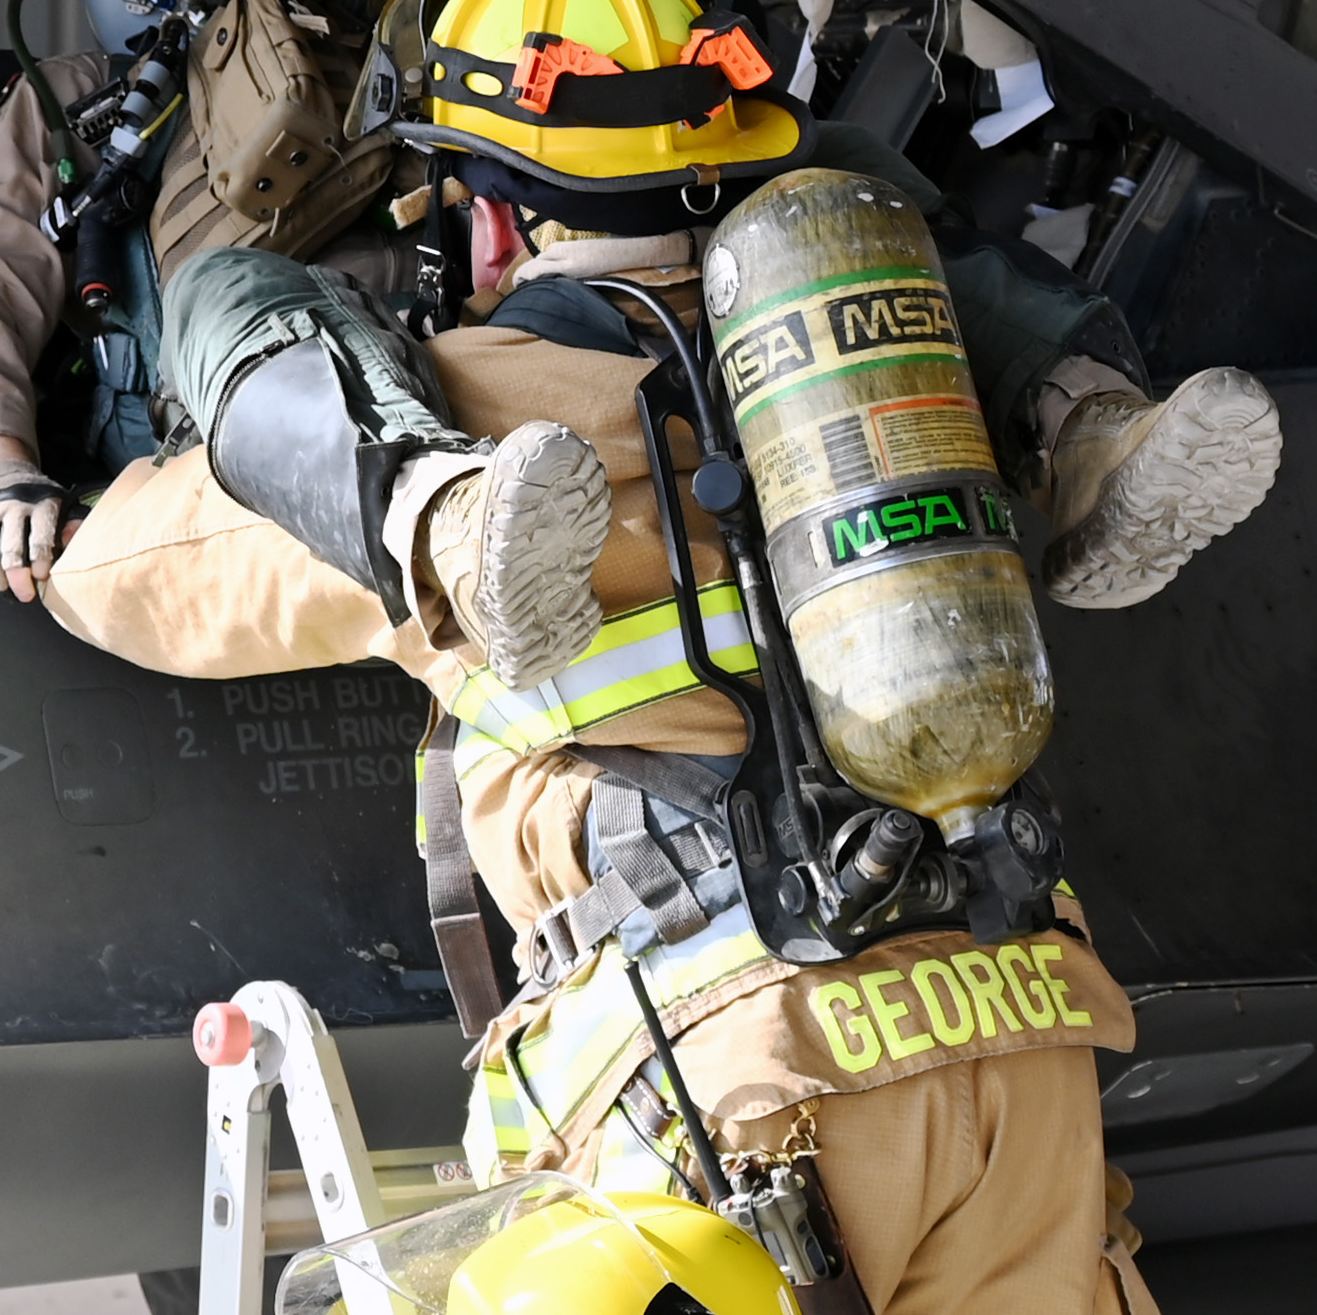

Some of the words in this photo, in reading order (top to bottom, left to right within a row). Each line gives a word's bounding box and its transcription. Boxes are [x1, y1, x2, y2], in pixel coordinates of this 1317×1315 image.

[842, 296, 958, 346] MSA
[724, 326, 807, 401] MSA
[831, 495, 967, 560] MSA
[166, 687, 195, 719] 1.
[221, 679, 321, 716] PUSH
[332, 675, 423, 710] BUTT
[175, 727, 208, 759] 2.
[236, 721, 325, 755] PULL
[817, 943, 1093, 1074] GEORGE
